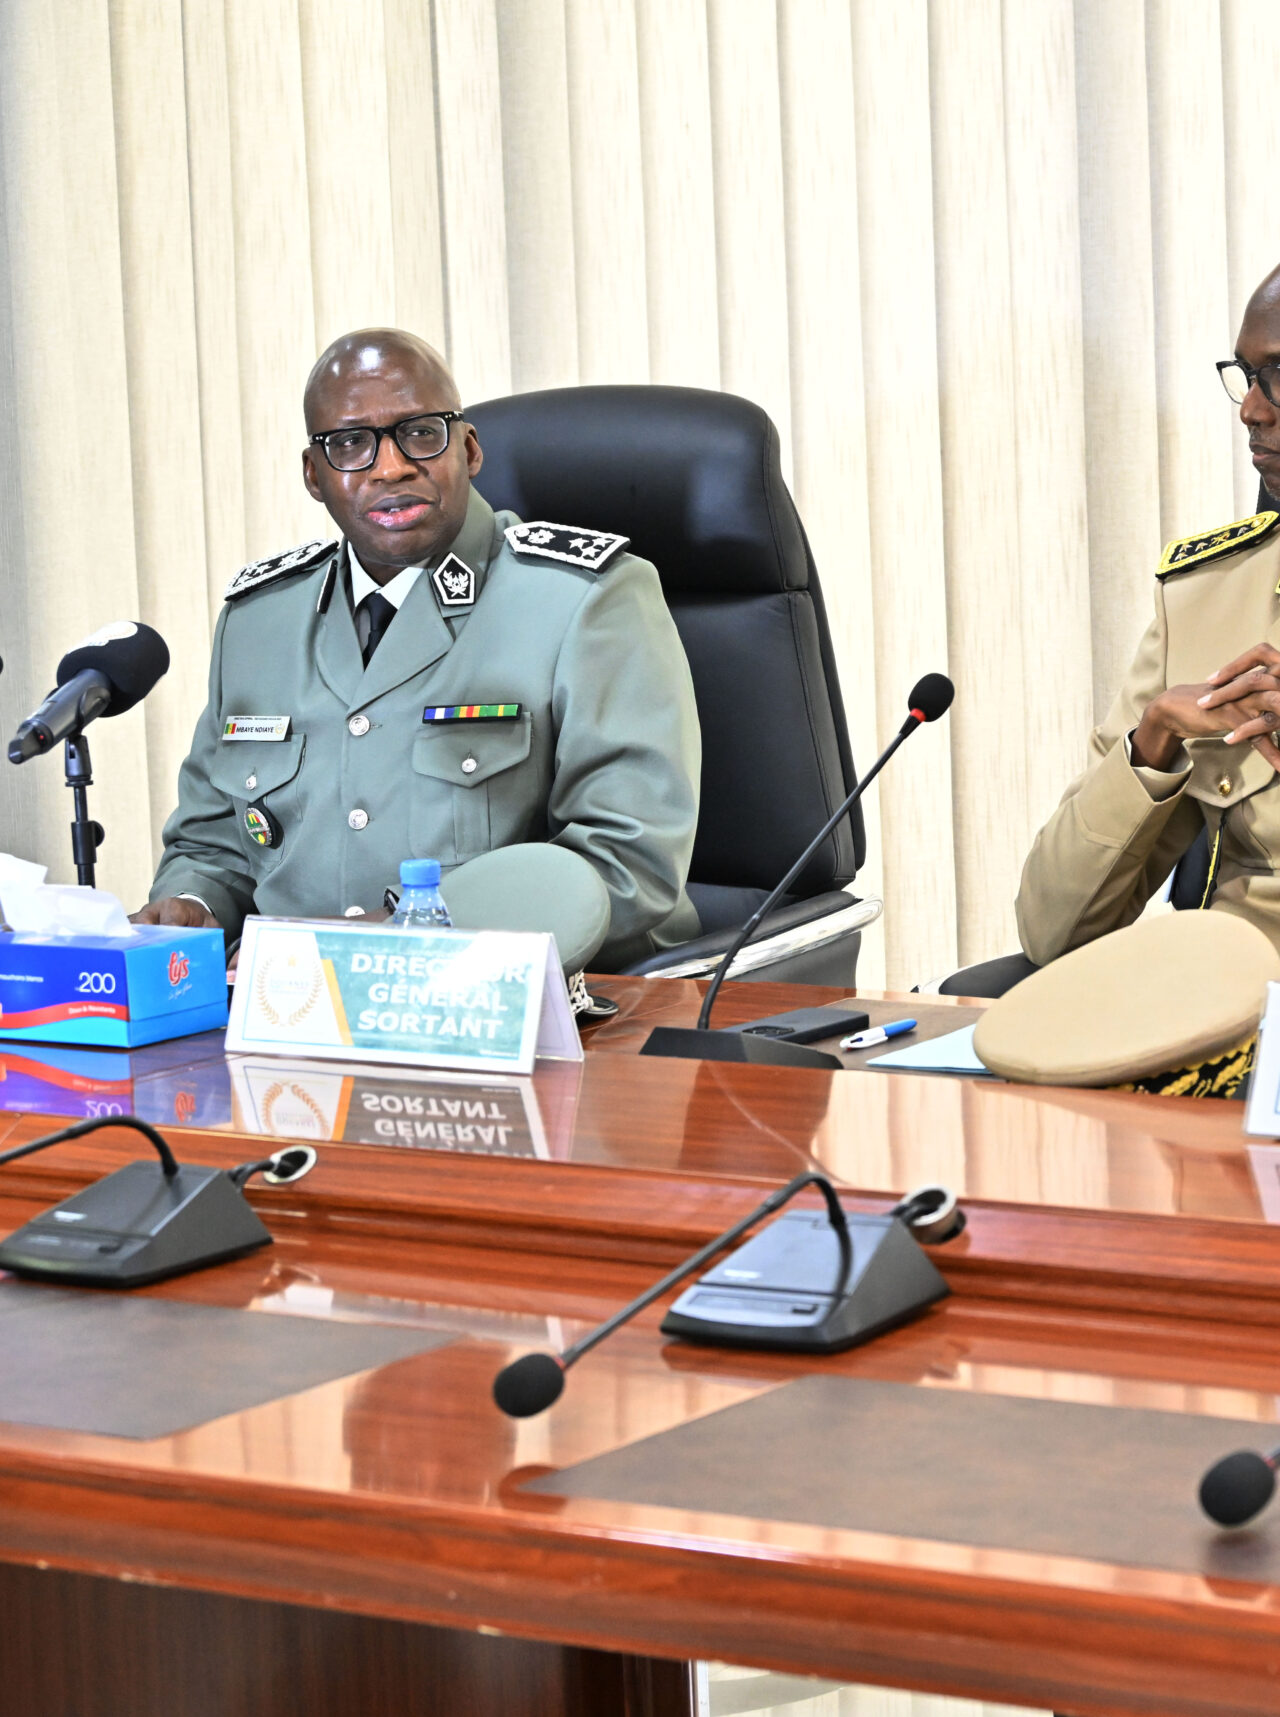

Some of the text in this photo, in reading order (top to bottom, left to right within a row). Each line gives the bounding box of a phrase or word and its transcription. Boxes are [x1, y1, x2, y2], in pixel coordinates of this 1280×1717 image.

[78, 971, 116, 994] 200
[351, 953, 526, 983] DIRECR
[357, 1010, 503, 1039] SORTANT
